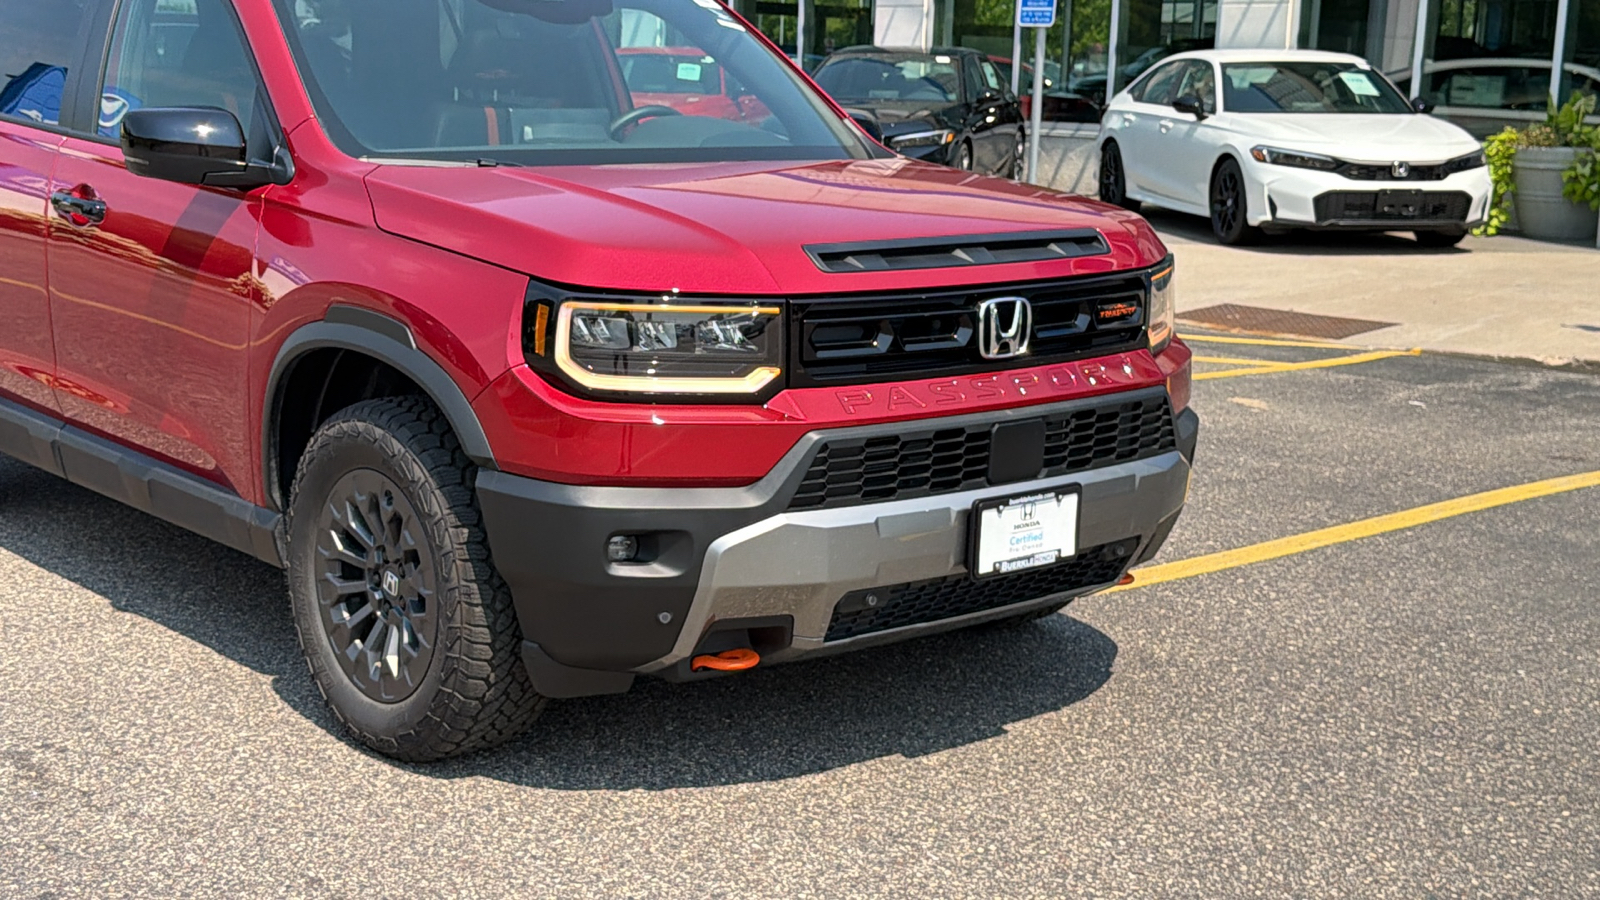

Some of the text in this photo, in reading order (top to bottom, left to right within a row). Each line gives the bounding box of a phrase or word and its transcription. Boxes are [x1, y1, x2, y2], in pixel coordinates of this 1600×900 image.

[835, 354, 1133, 414] PASSPORT
[1013, 520, 1040, 530] HONDA
[1009, 532, 1043, 545] Certified
